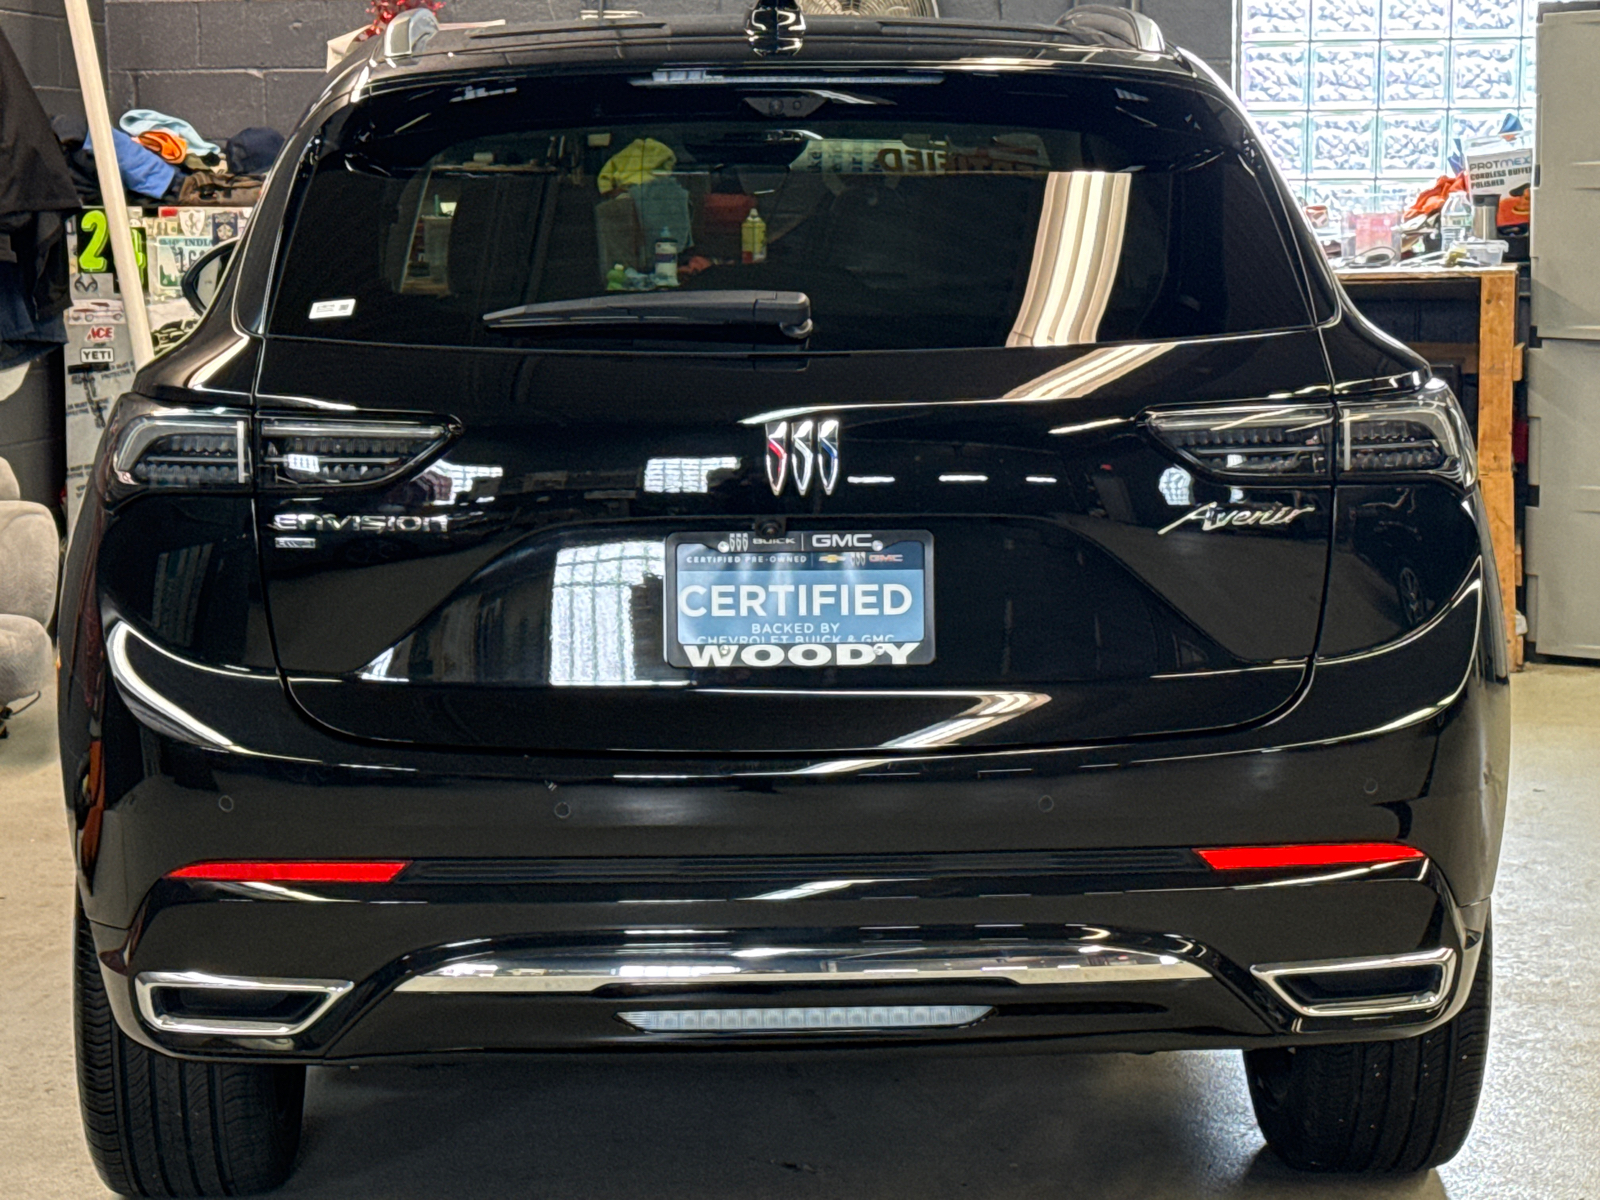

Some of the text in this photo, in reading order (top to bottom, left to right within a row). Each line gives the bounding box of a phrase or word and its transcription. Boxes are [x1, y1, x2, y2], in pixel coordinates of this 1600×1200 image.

[1469, 156, 1531, 171] PROTMEX
[1470, 167, 1532, 181] CORDLESS BUFFE
[1471, 178, 1505, 189] POLISHER
[87, 327, 113, 340] ACE
[82, 350, 112, 360] YETI
[274, 513, 449, 532] ENVISION
[1157, 501, 1315, 535] Avenir
[752, 533, 873, 548] BUICK GMC
[686, 555, 741, 563] CERTIFIED
[869, 554, 903, 562] GMC
[680, 584, 913, 617] CERTIFIED
[751, 623, 840, 634] BACKED BY
[683, 643, 920, 667] WOODY
